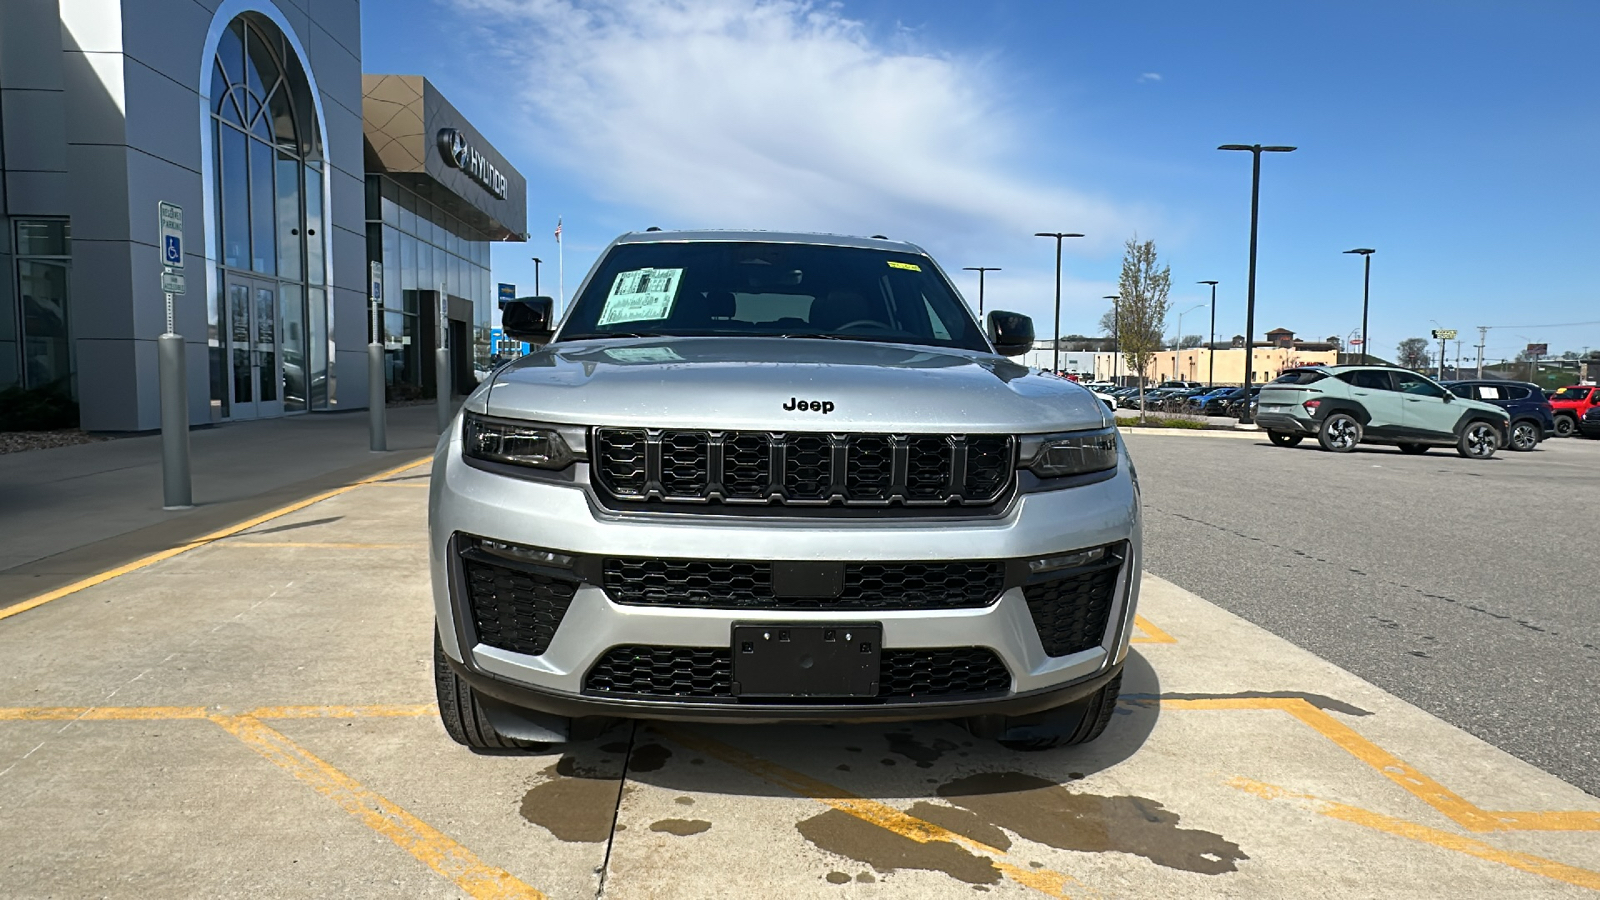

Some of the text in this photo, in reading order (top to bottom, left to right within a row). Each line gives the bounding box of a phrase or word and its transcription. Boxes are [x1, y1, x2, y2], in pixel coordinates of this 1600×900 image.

[471, 146, 508, 200] HYUNDAI
[162, 219, 182, 231] PARKING
[783, 397, 835, 415] Jeep
